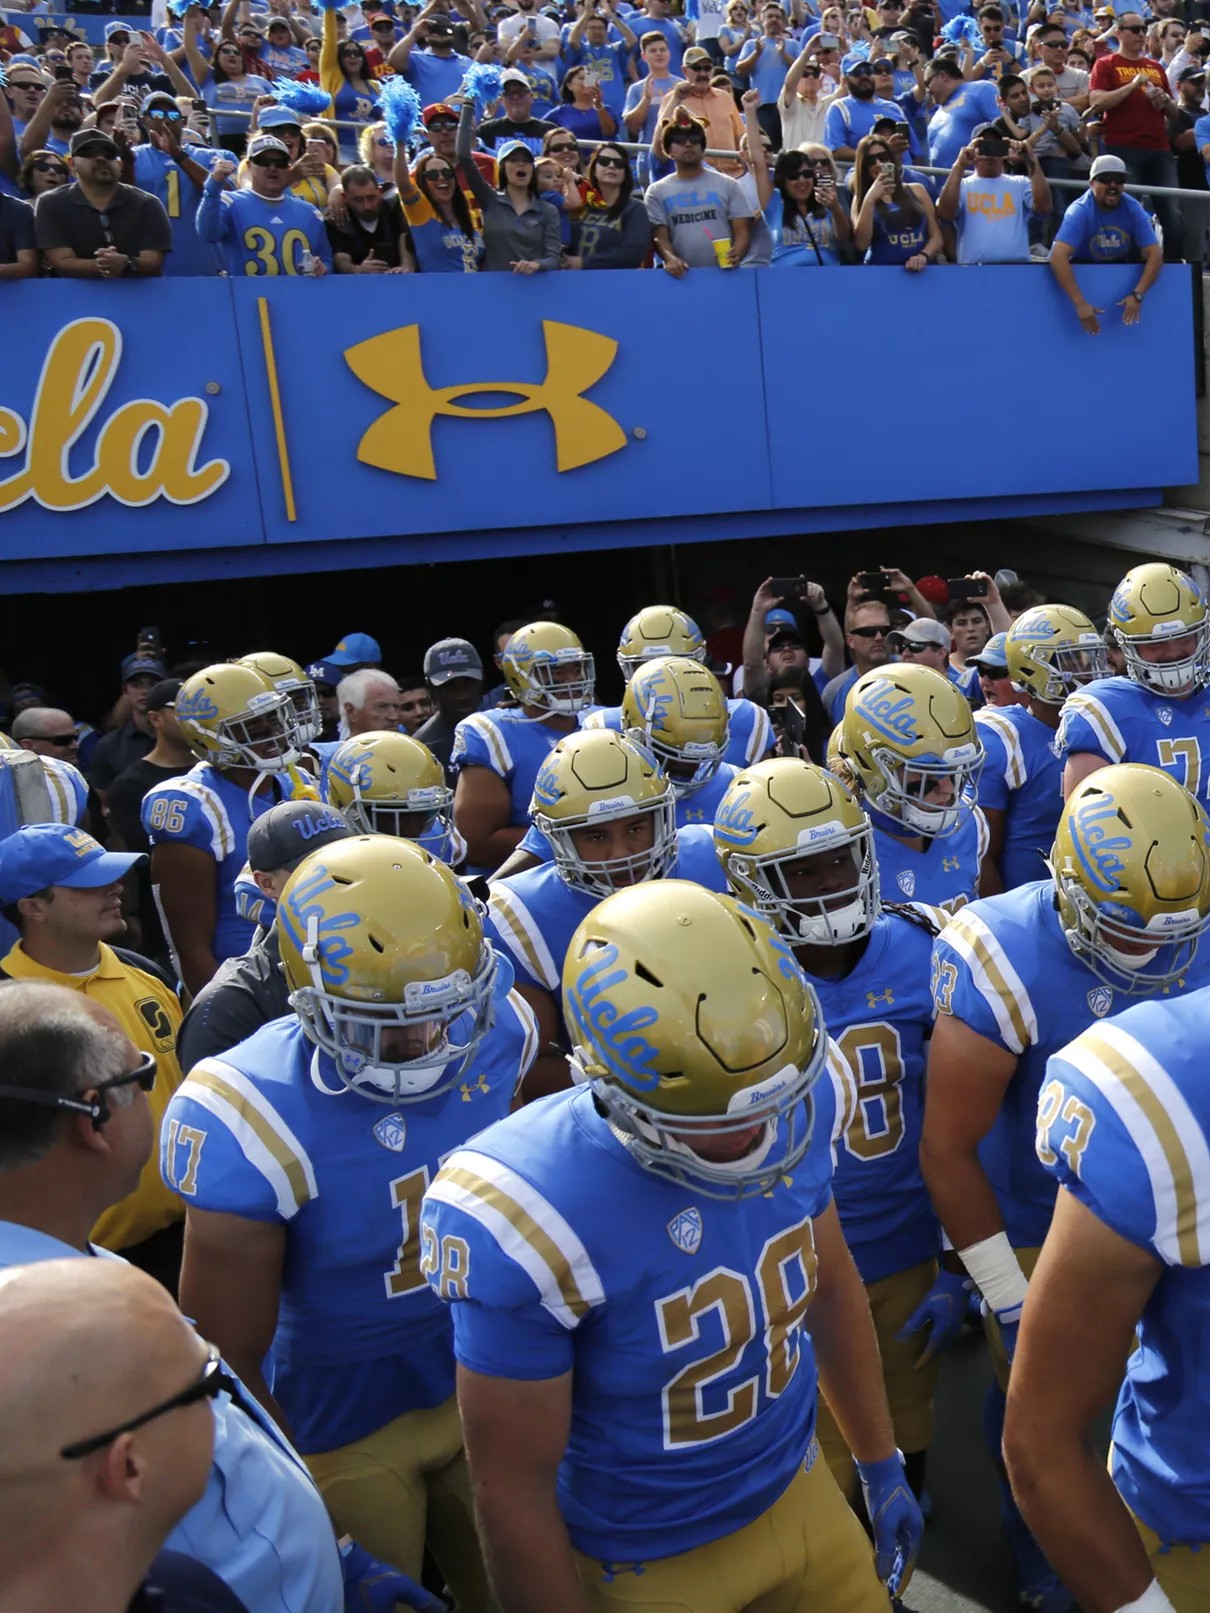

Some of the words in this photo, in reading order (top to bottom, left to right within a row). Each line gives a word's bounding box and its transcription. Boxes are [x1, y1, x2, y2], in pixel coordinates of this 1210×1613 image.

[1115, 66, 1161, 79] TROJANS
[165, 169, 181, 218] 1
[967, 191, 1016, 216] UCLA
[671, 208, 718, 226] MEDICINE
[243, 225, 311, 276] 30
[888, 231, 924, 247] UCLA
[1010, 612, 1055, 642] Ucla
[854, 678, 920, 746] Ucla
[149, 798, 188, 833] 86
[598, 800, 625, 812] Bruins
[292, 809, 346, 840] Ucla
[809, 826, 837, 840] Bruins
[1069, 793, 1134, 893] Ucla
[280, 864, 361, 986] Ucla
[1161, 914, 1191, 927] Bruins
[421, 981, 451, 996] Bruins
[565, 944, 661, 1092] Ucla
[750, 1080, 787, 1105] Bruins
[160, 1118, 208, 1197] 17
[682, 1227, 699, 1250] 12
[421, 1222, 471, 1301] 28
[655, 1215, 818, 1451] 28
